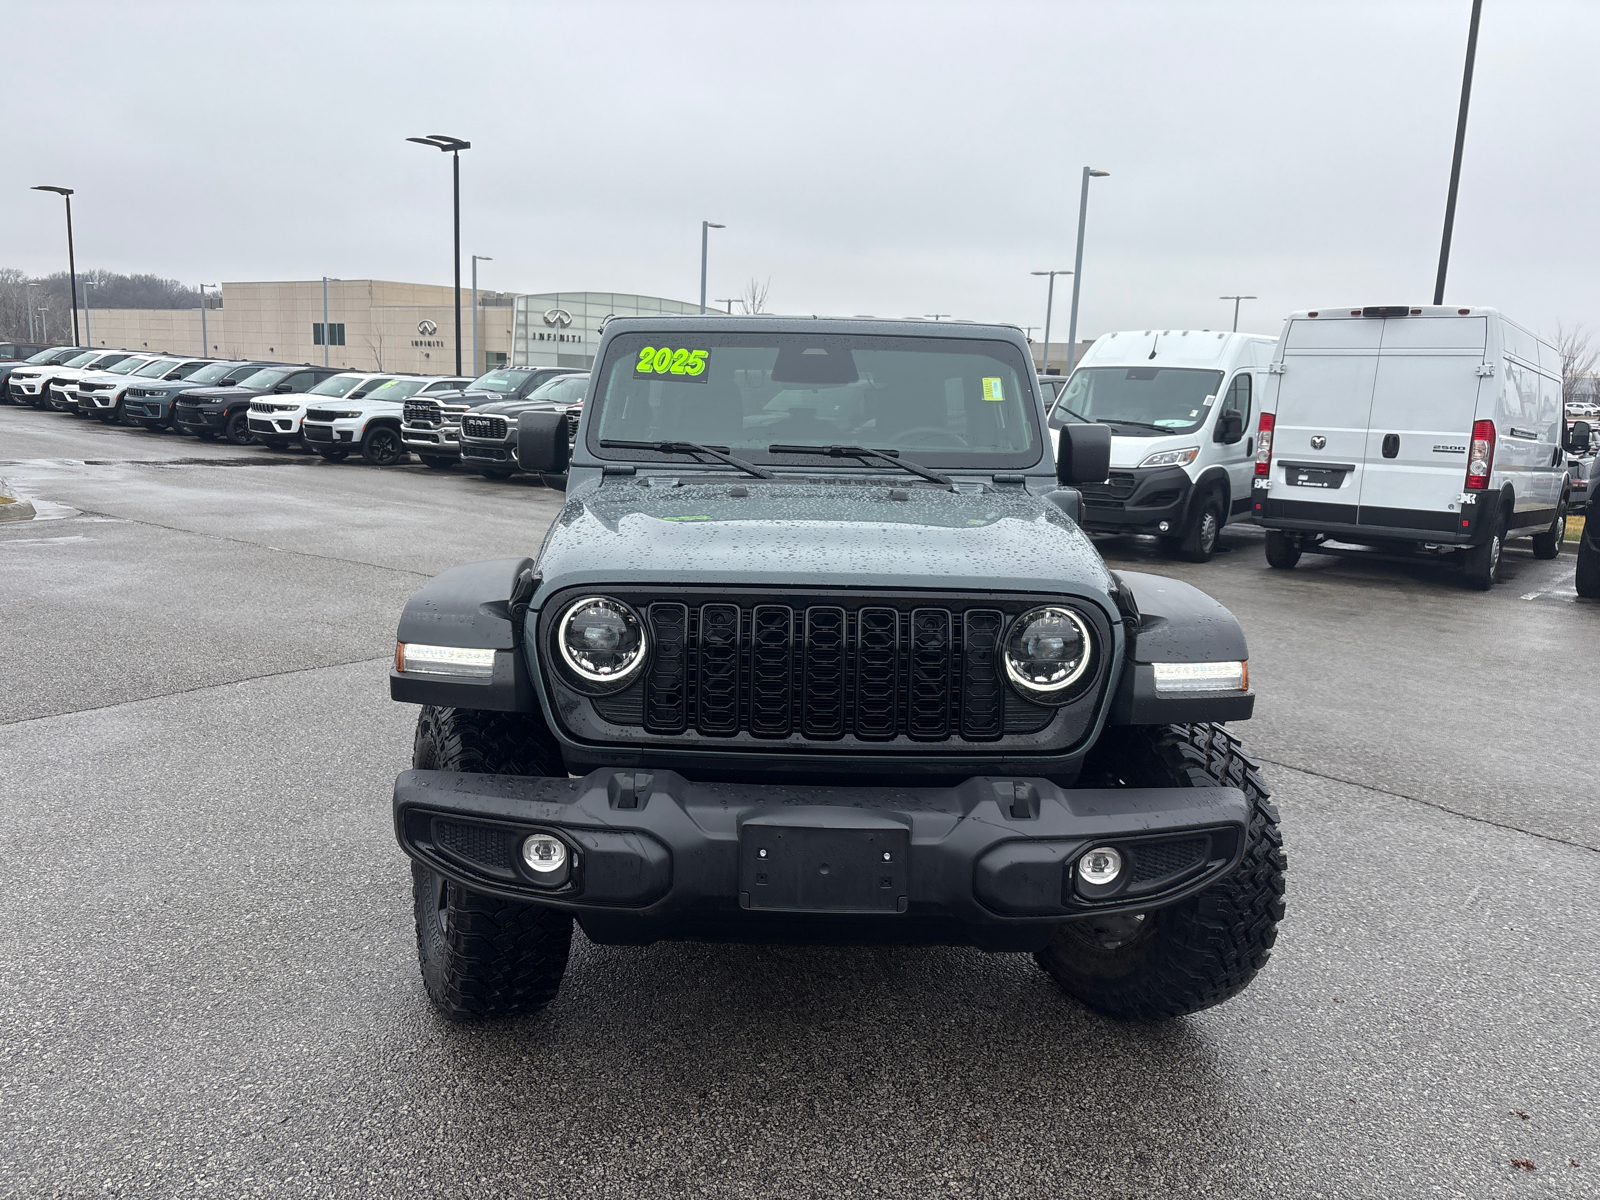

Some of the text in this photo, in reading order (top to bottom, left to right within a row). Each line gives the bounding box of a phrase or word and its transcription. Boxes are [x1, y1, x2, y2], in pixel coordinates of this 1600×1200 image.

[532, 332, 582, 343] INFINITI
[411, 340, 444, 348] INFINITI
[636, 346, 709, 376] 2025
